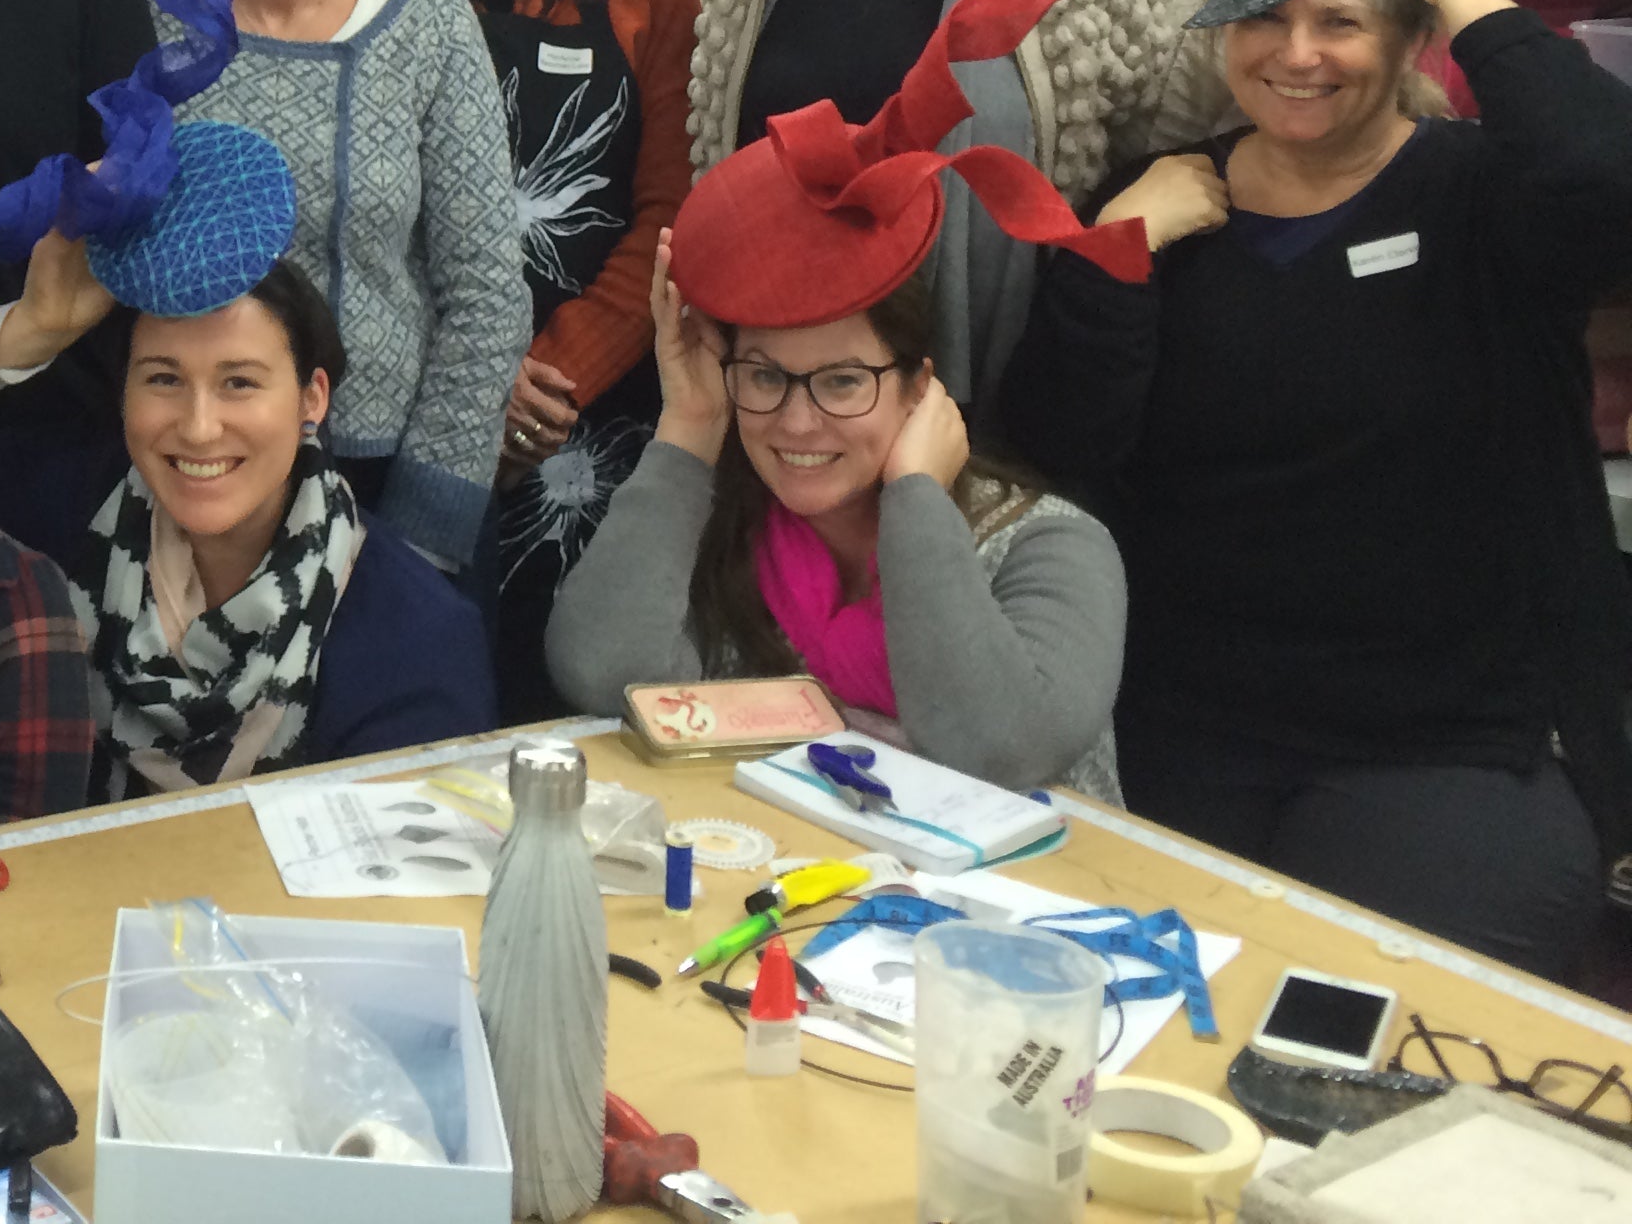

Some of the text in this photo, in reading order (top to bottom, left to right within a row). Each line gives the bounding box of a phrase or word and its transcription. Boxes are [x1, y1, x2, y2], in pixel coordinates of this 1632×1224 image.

[997, 1039, 1043, 1089] MADE IN
[1012, 1045, 1064, 1108] AUSTRALIA
